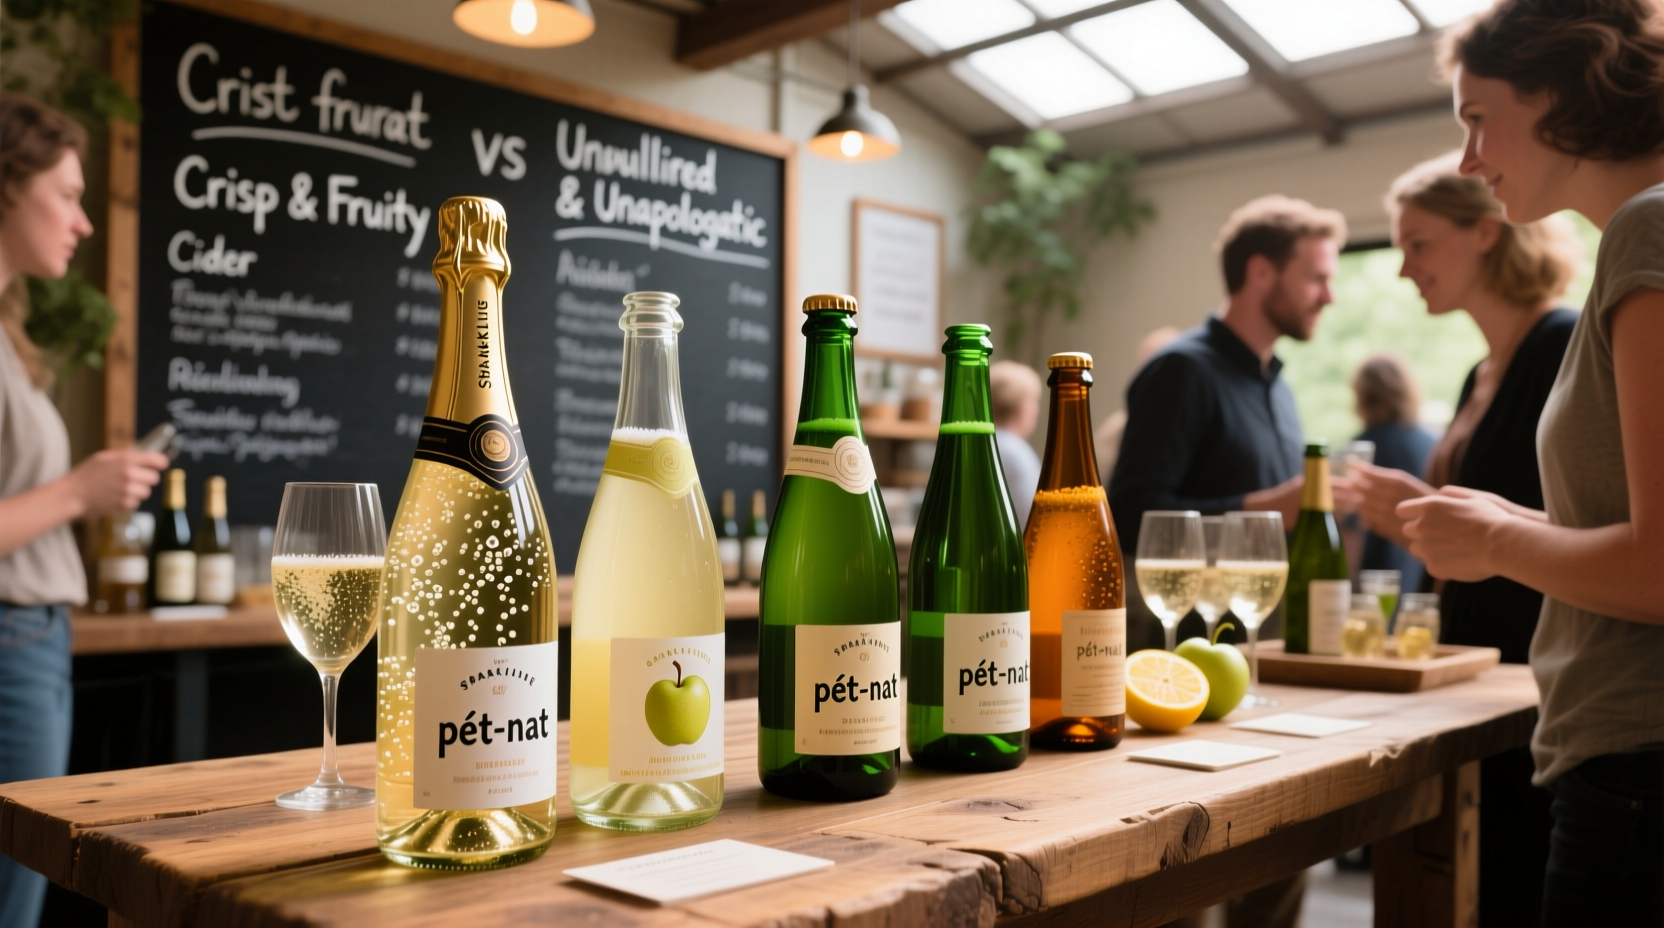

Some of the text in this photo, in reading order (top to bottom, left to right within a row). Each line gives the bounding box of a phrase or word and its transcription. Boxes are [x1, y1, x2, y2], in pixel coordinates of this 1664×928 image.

[177, 43, 300, 122] Crist
[173, 155, 431, 258] Crisp & Fruity
[555, 175, 585, 220] &
[167, 230, 258, 277] Cider
[814, 673, 898, 713] pét-nat
[959, 659, 1029, 696] pét-nat
[438, 708, 549, 759] pét-nat
